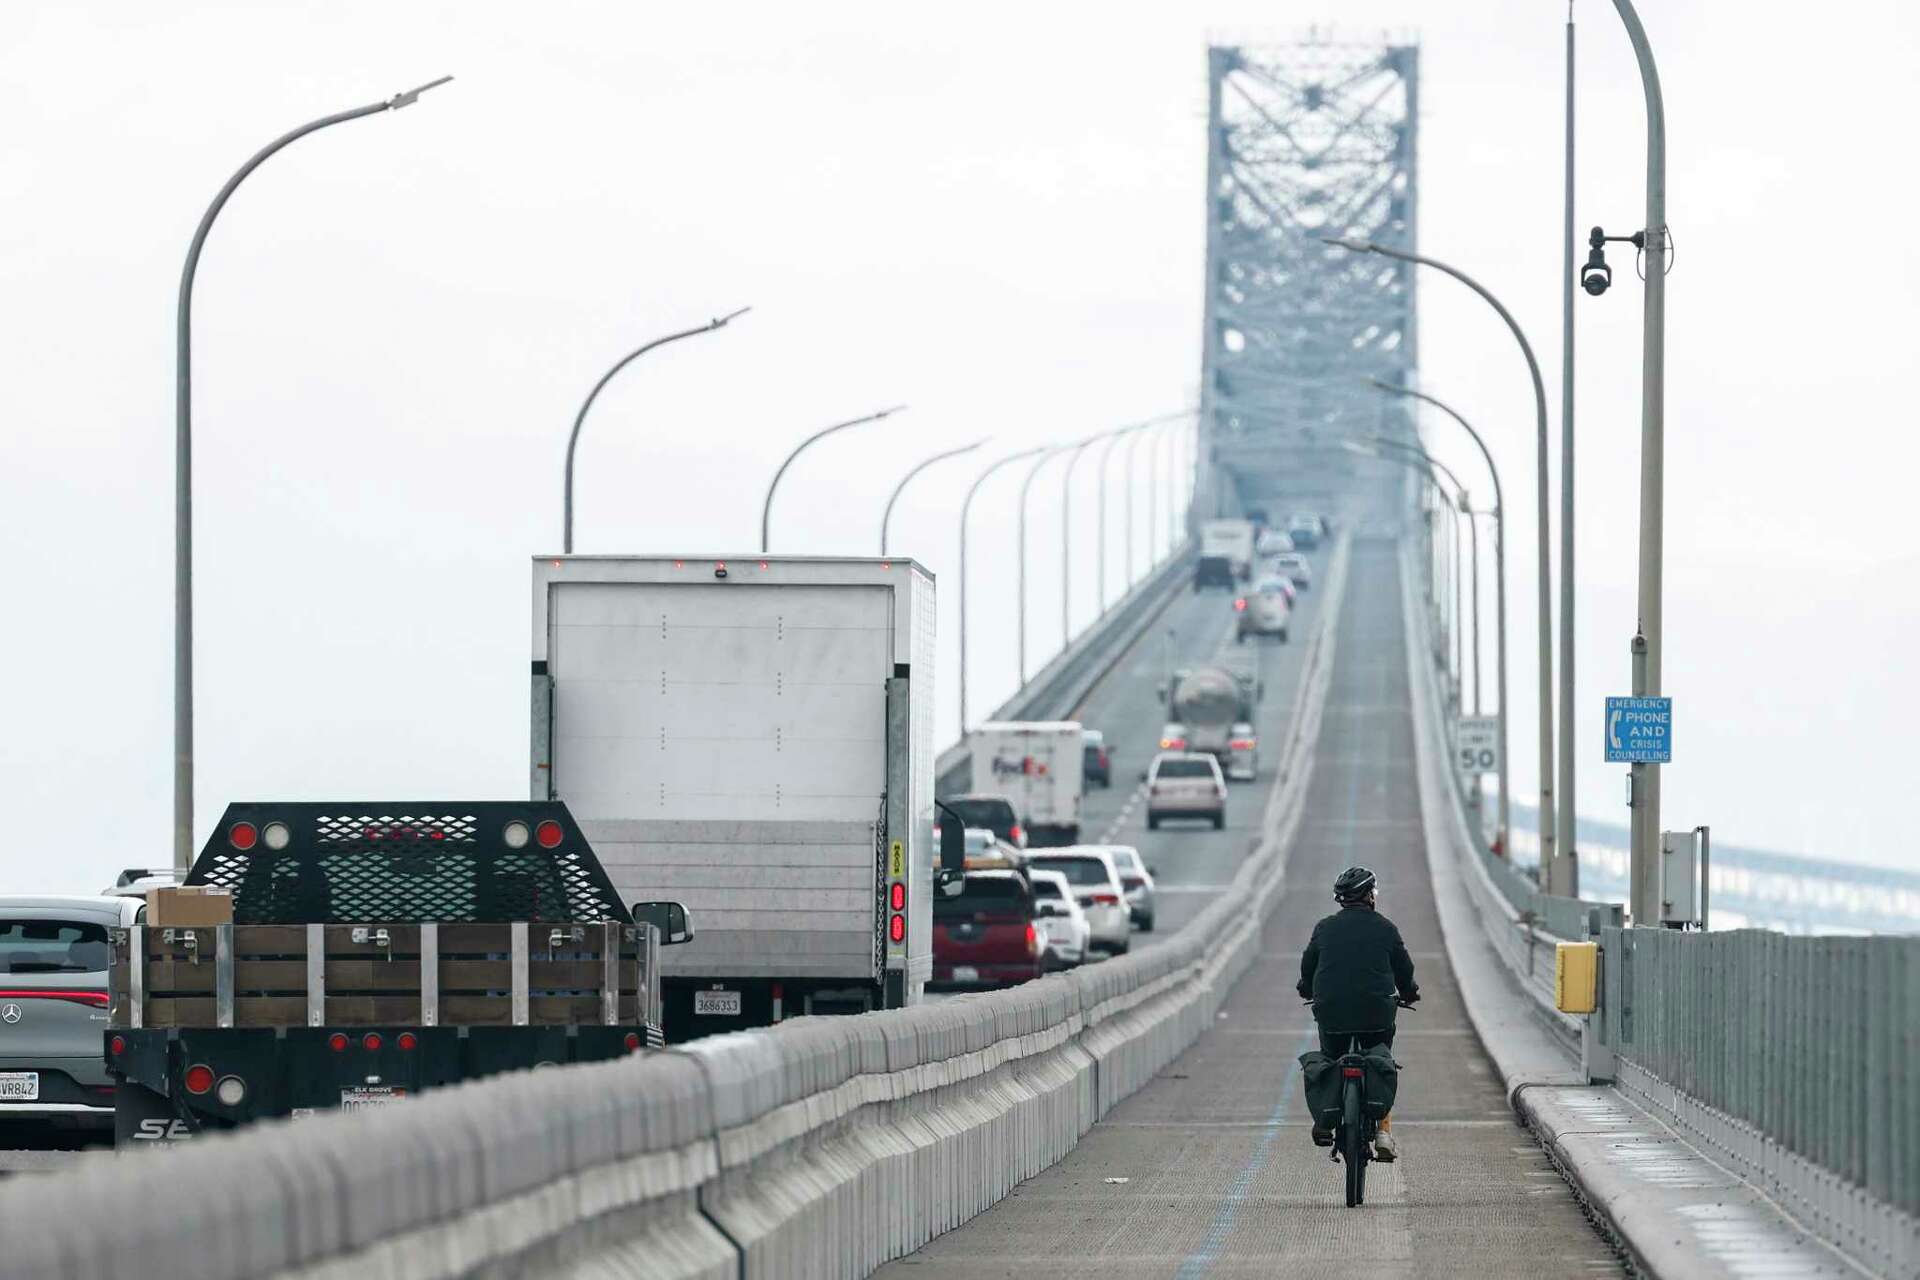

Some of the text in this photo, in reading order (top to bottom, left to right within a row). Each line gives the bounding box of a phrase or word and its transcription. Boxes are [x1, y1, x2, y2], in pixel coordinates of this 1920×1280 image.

[1609, 699, 1669, 709] EMERGENCY
[1625, 712, 1669, 723] PHONE
[1630, 726, 1665, 737] AND
[1631, 739, 1662, 749] CRISIS
[1461, 748, 1495, 770] 50
[1609, 751, 1669, 760] COUNSELING
[0, 1082, 35, 1096] VR842
